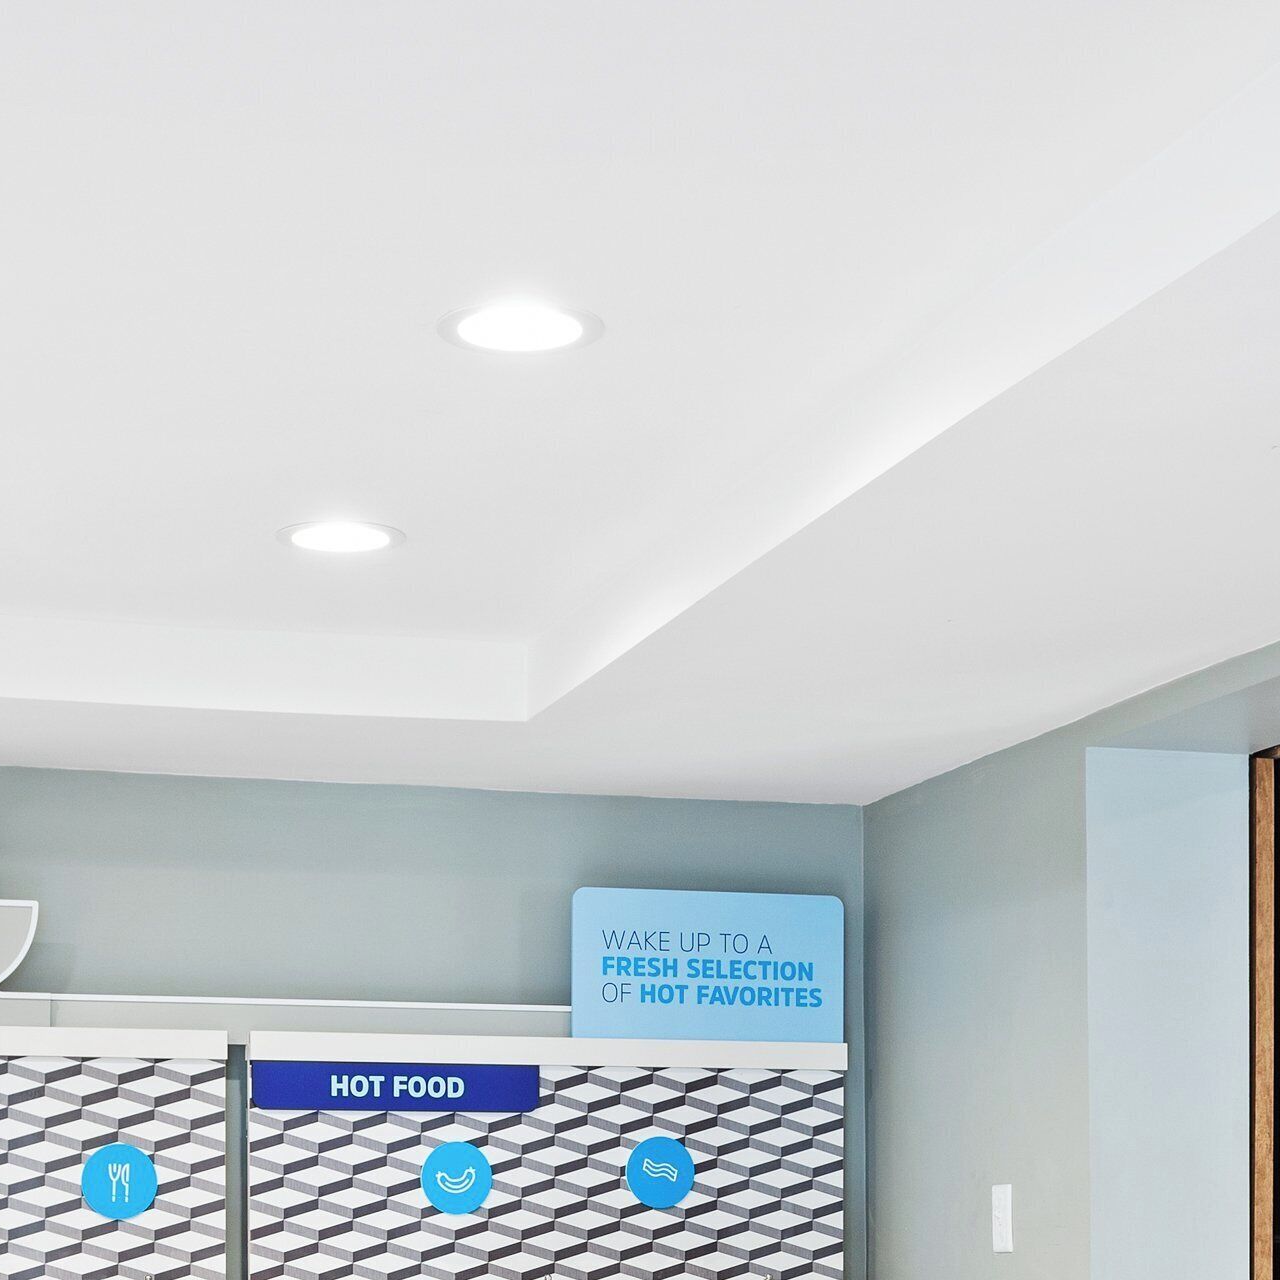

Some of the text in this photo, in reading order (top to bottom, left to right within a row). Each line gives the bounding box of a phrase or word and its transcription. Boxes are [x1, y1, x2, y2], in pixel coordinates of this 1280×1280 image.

[602, 929, 773, 954] WAKE UP TO A
[602, 956, 814, 981] FRESH SELECTION
[602, 982, 823, 1008] OF HOT FAVORITES
[331, 1075, 465, 1099] HOT FOOD
